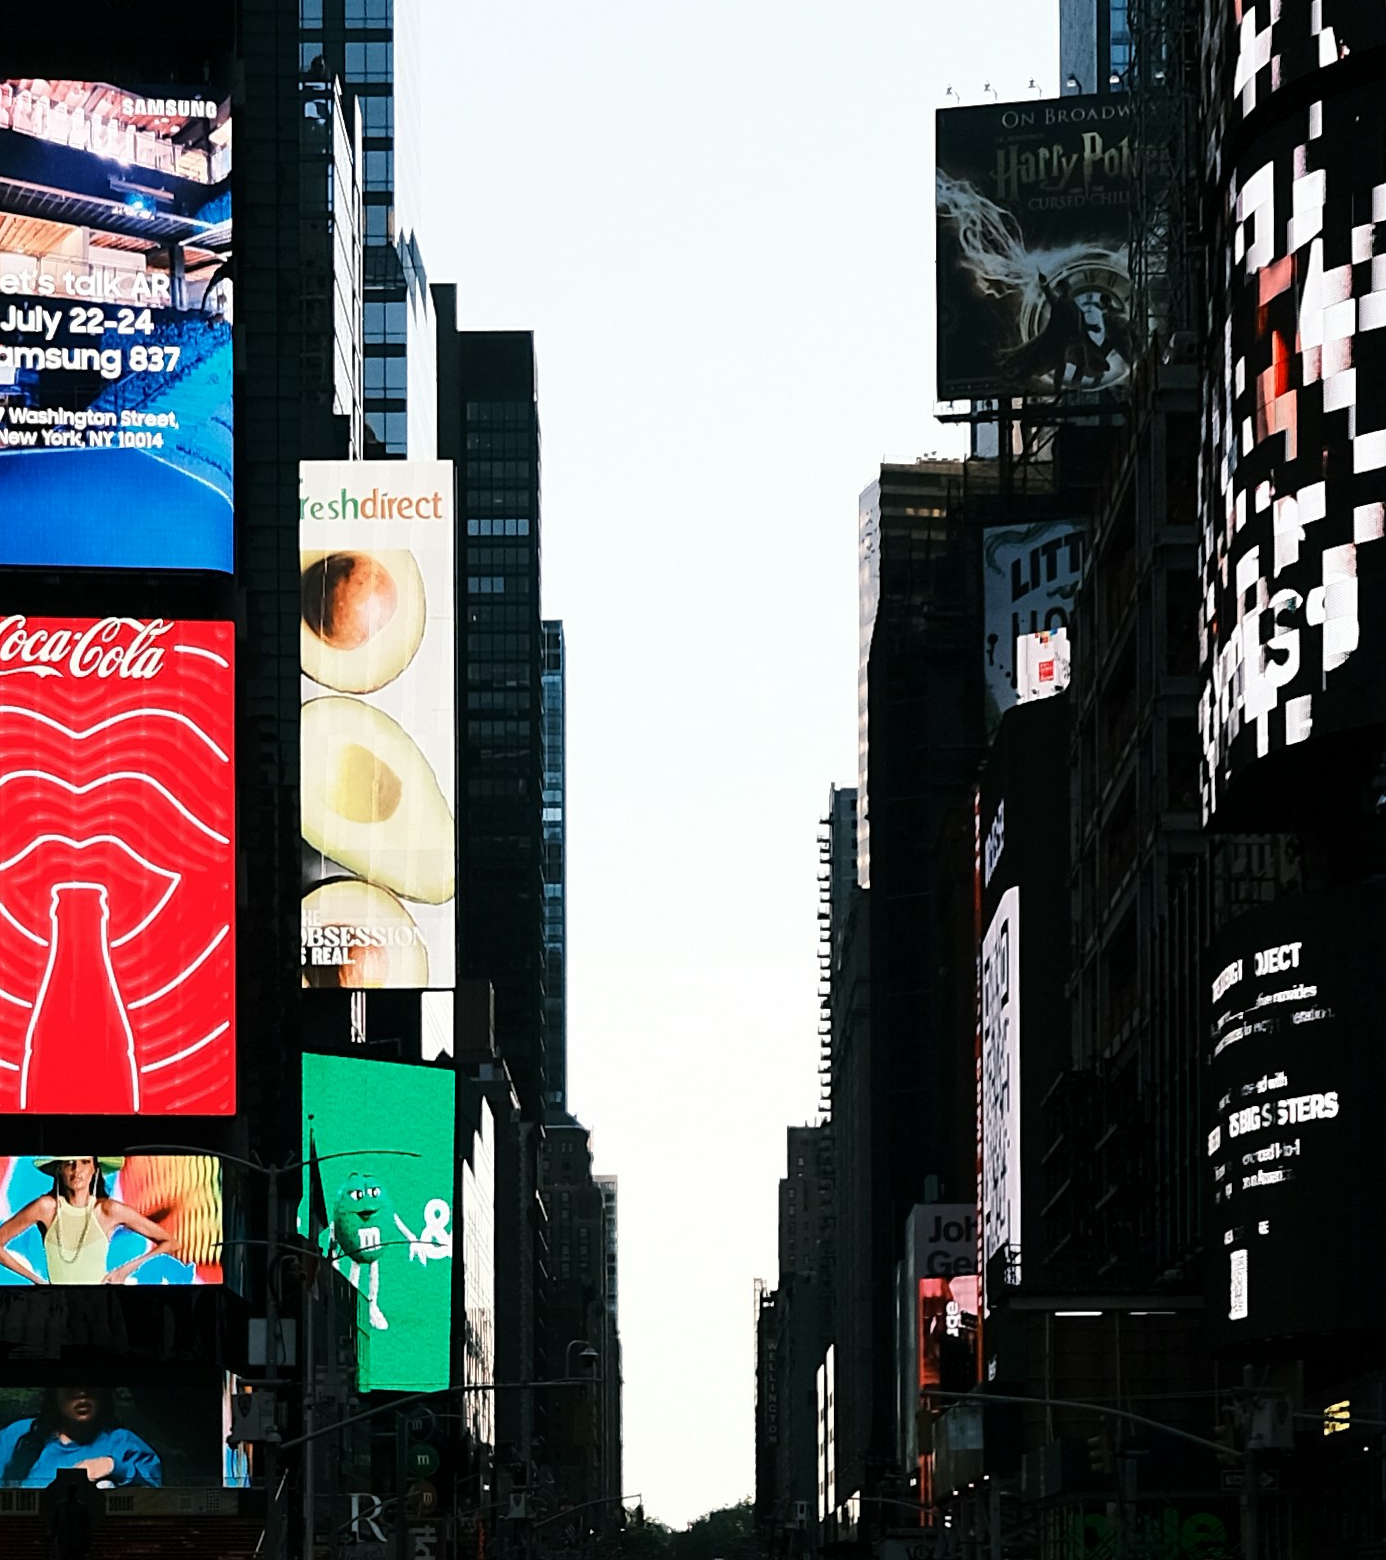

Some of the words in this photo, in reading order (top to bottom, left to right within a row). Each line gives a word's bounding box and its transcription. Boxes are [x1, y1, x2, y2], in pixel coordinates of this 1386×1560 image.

[122, 98, 216, 119] SAMSUNG
[991, 139, 1078, 202] Harry
[1028, 195, 1085, 210] CURSED
[67, 268, 122, 296] talk
[131, 273, 170, 298] AR
[0, 304, 60, 341] July
[69, 307, 154, 335] 22-24
[129, 346, 181, 372] 837
[9, 407, 116, 429] Washington
[121, 411, 179, 429] Street,
[40, 428, 86, 448] York,
[89, 430, 116, 448] NY
[119, 431, 164, 449] 10014
[300, 487, 443, 521] reshdirect
[929, 1215, 977, 1244] Joh
[927, 1250, 971, 1276] Ge
[767, 1340, 780, 1444] WELLINGTON
[416, 1453, 430, 1466] m
[348, 1491, 389, 1544] R
